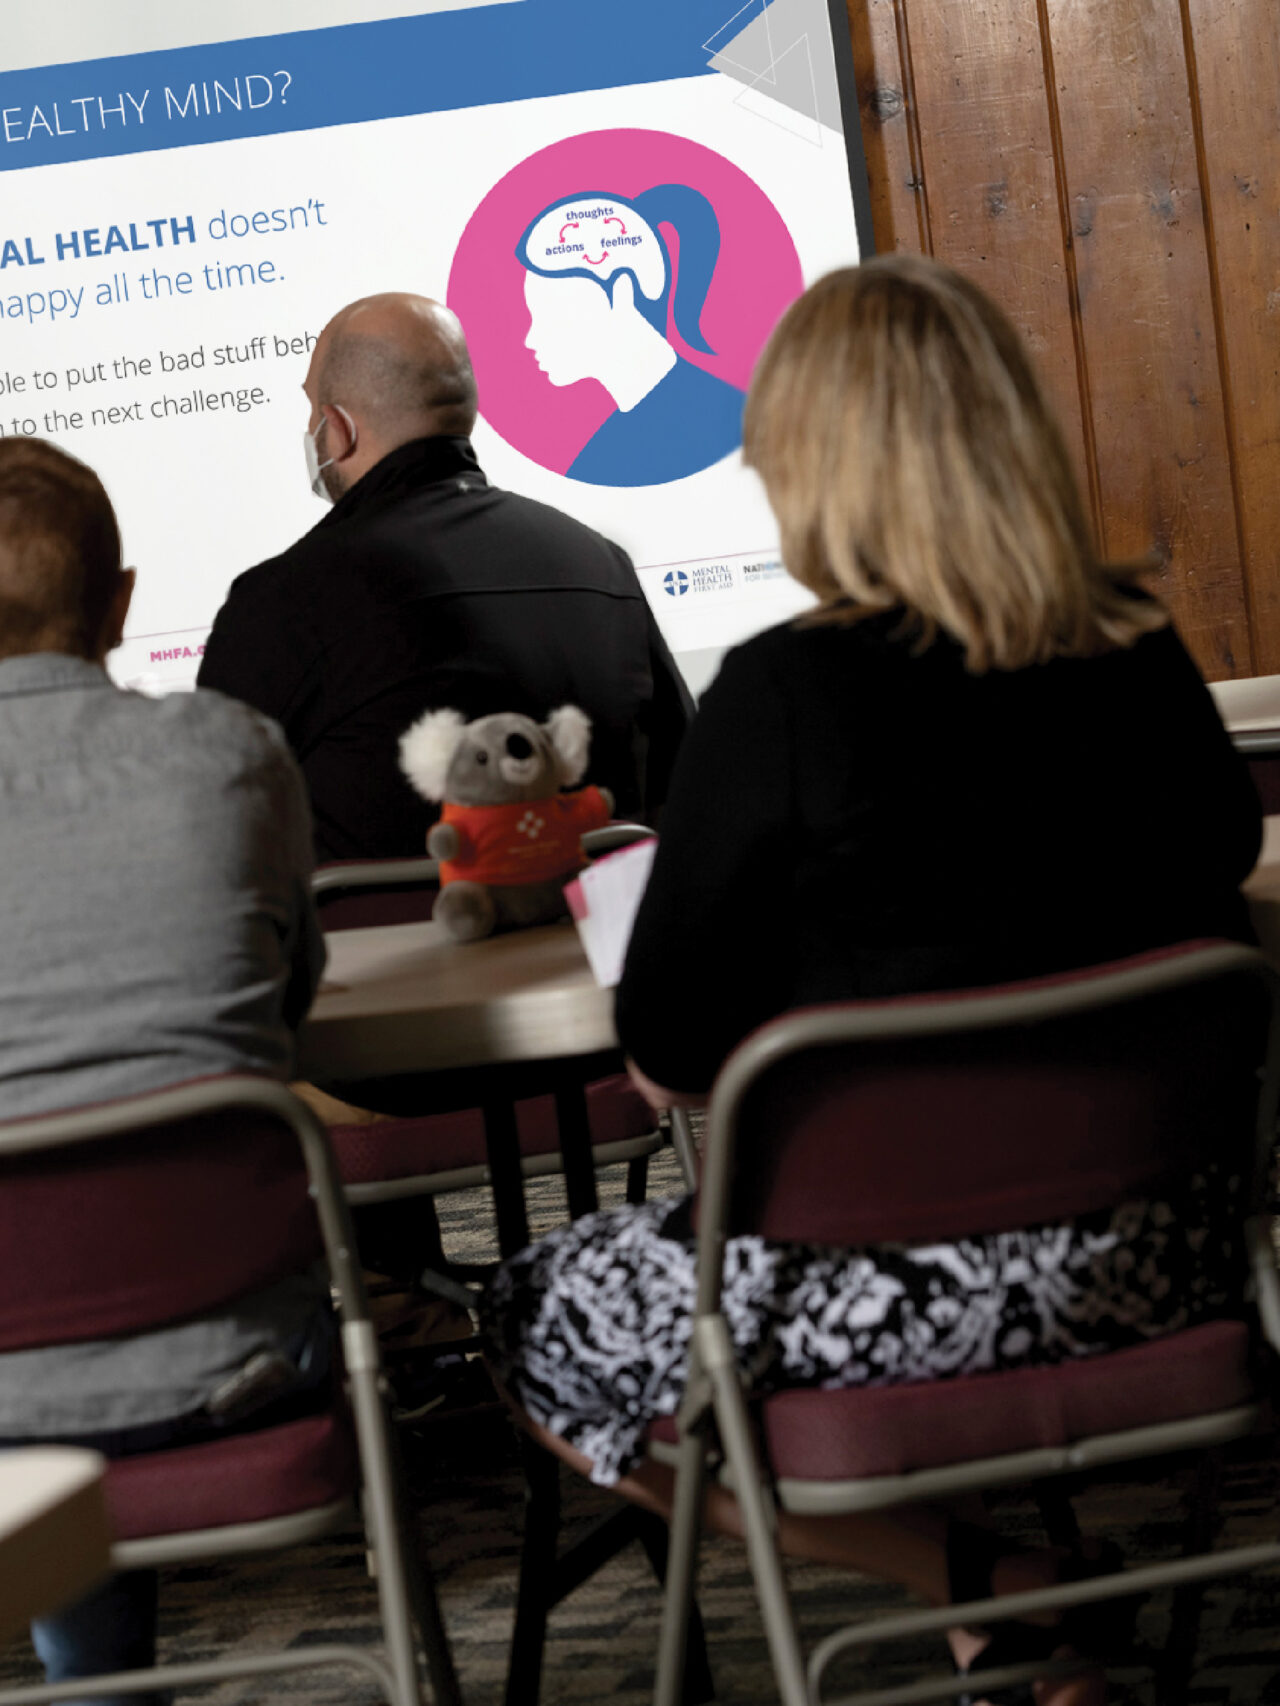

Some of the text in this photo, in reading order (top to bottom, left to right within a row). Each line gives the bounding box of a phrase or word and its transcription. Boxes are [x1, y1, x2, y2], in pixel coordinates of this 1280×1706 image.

[164, 70, 292, 120] MIND?
[566, 207, 614, 220] thoughts
[55, 215, 197, 262] HEALTH
[208, 198, 328, 240] doesn’t
[600, 235, 642, 248] feelings
[545, 243, 585, 255] actions
[96, 273, 130, 306] all
[138, 267, 193, 299] the
[202, 260, 285, 291] time.
[32, 370, 58, 390] to
[65, 362, 108, 392] put
[112, 355, 152, 380] the
[159, 350, 205, 373] bad
[213, 336, 267, 366] stuff
[273, 330, 320, 357] beh
[11, 417, 37, 436] to
[43, 410, 84, 433] the
[91, 401, 145, 426] next
[150, 387, 271, 419] challenge.
[692, 565, 730, 577] MENTAL
[693, 574, 732, 586] HEALTH
[694, 584, 716, 592] FIRST
